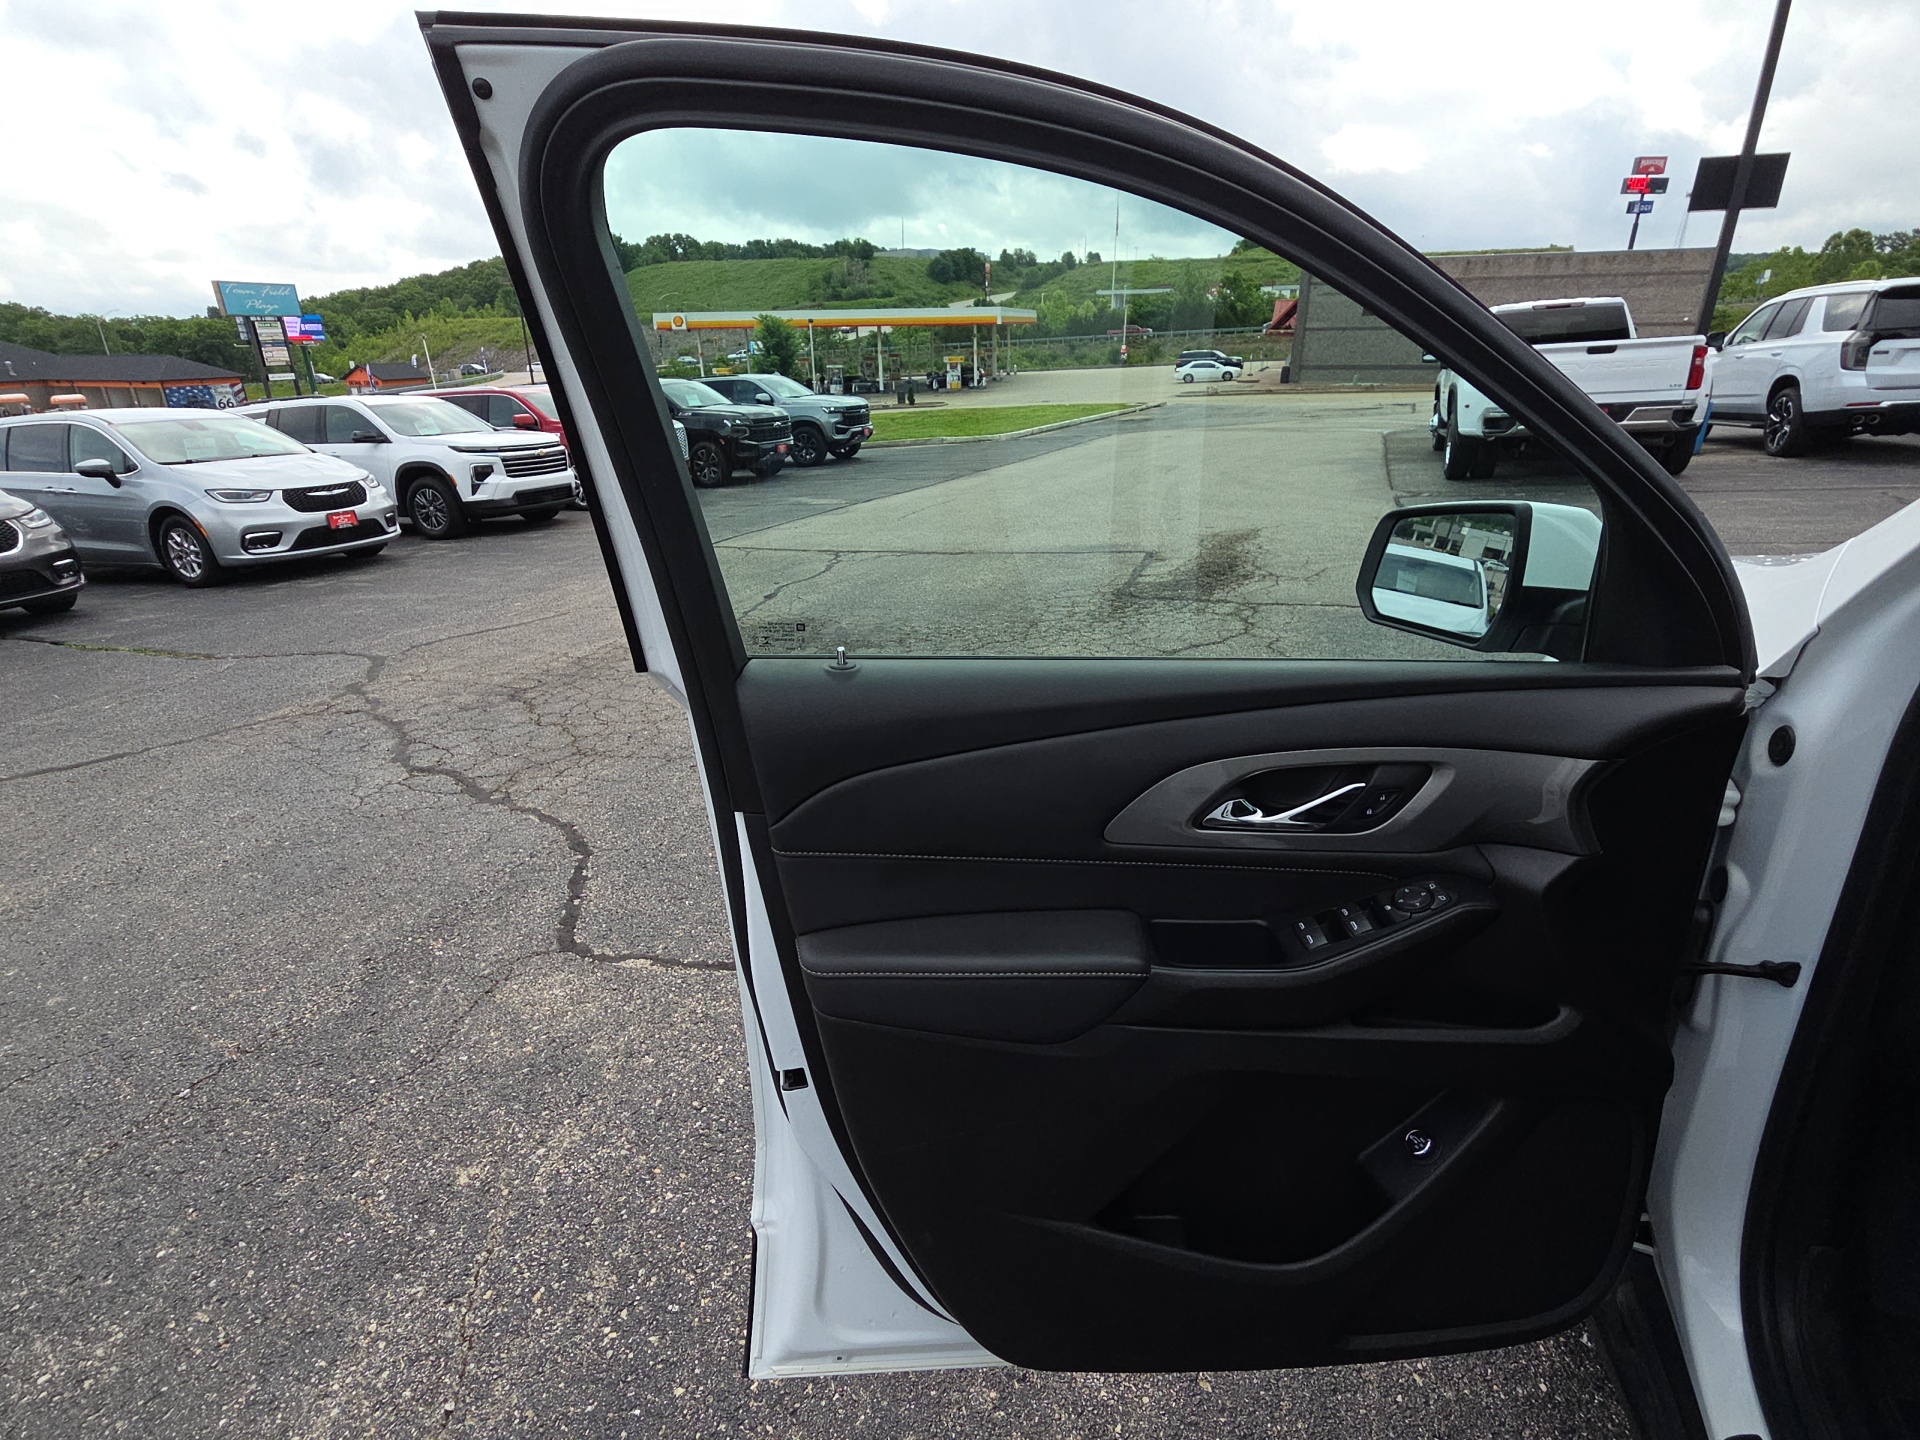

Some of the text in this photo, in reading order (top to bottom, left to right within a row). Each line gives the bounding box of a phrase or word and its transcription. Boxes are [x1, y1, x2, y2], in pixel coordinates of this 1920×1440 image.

[225, 283, 290, 297] Town Field
[218, 397, 235, 409] 66
